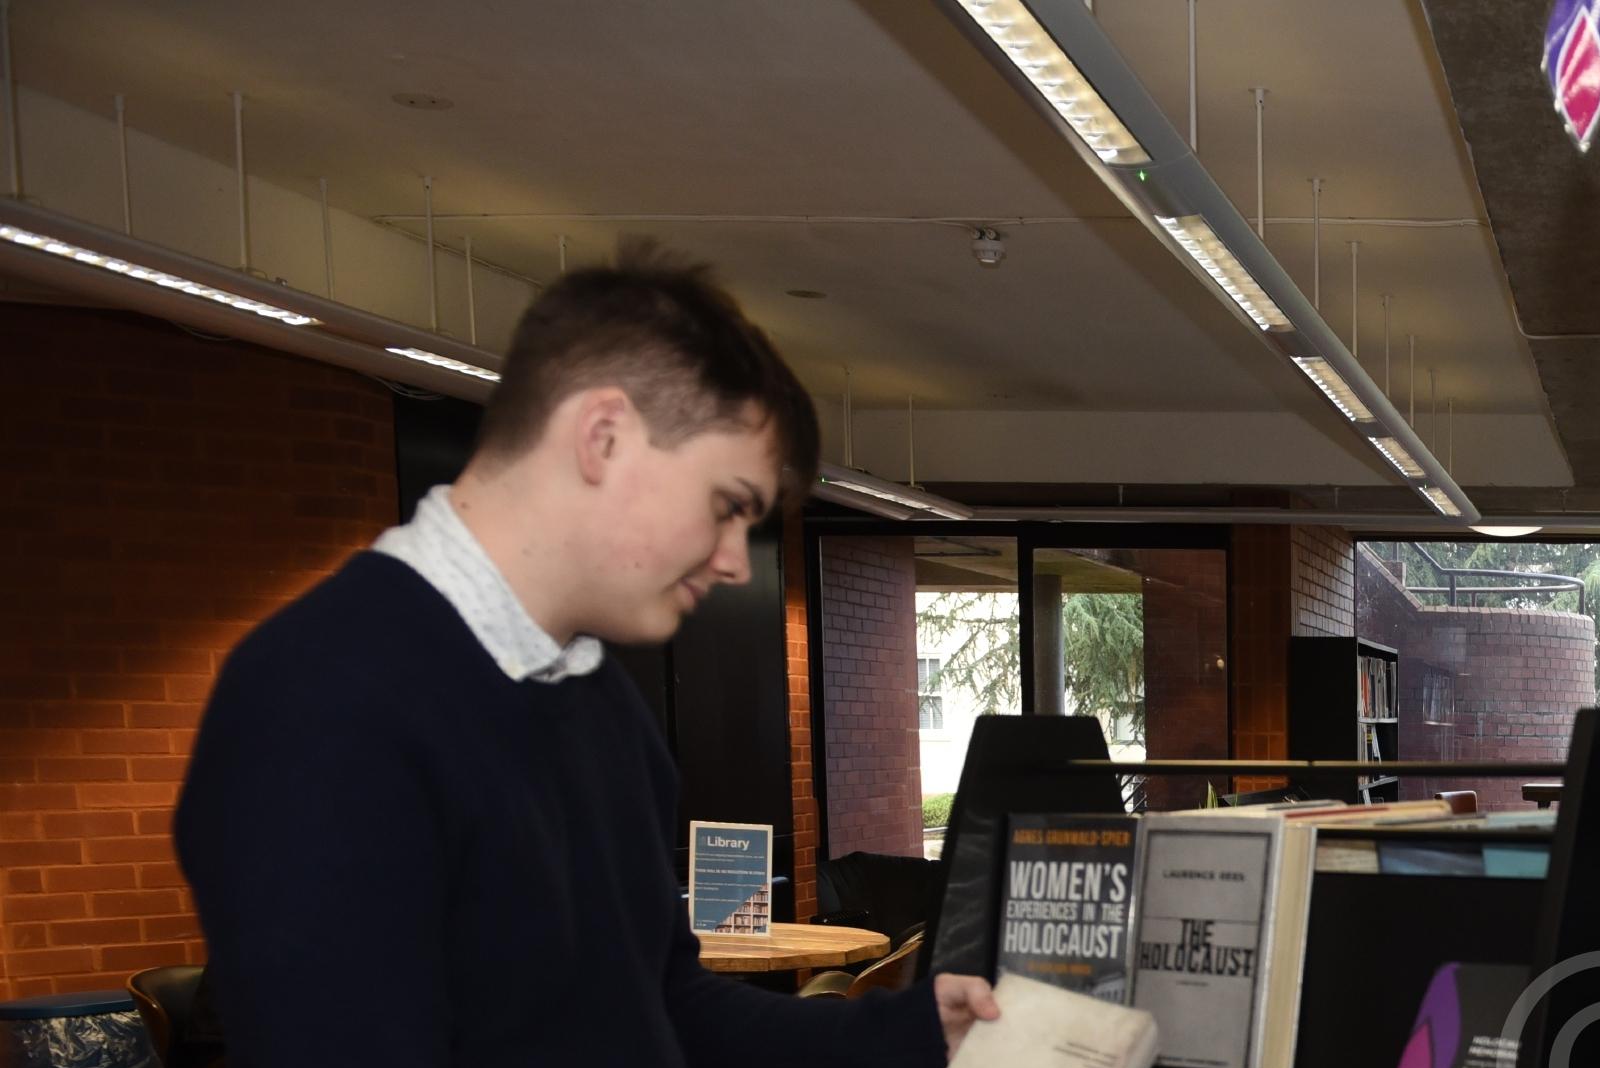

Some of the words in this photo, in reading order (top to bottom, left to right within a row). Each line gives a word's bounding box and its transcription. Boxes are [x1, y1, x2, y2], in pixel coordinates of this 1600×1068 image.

[707, 835, 750, 851] Library
[1010, 860, 1128, 902] WOMEN'S
[1006, 900, 1078, 920] EXPERIENCES
[1082, 902, 1096, 921] IN
[1101, 903, 1125, 923] THE
[1004, 920, 1124, 959] HOLOCAUST
[1180, 918, 1215, 951] THE
[1140, 941, 1255, 978] HOLOCAUST
